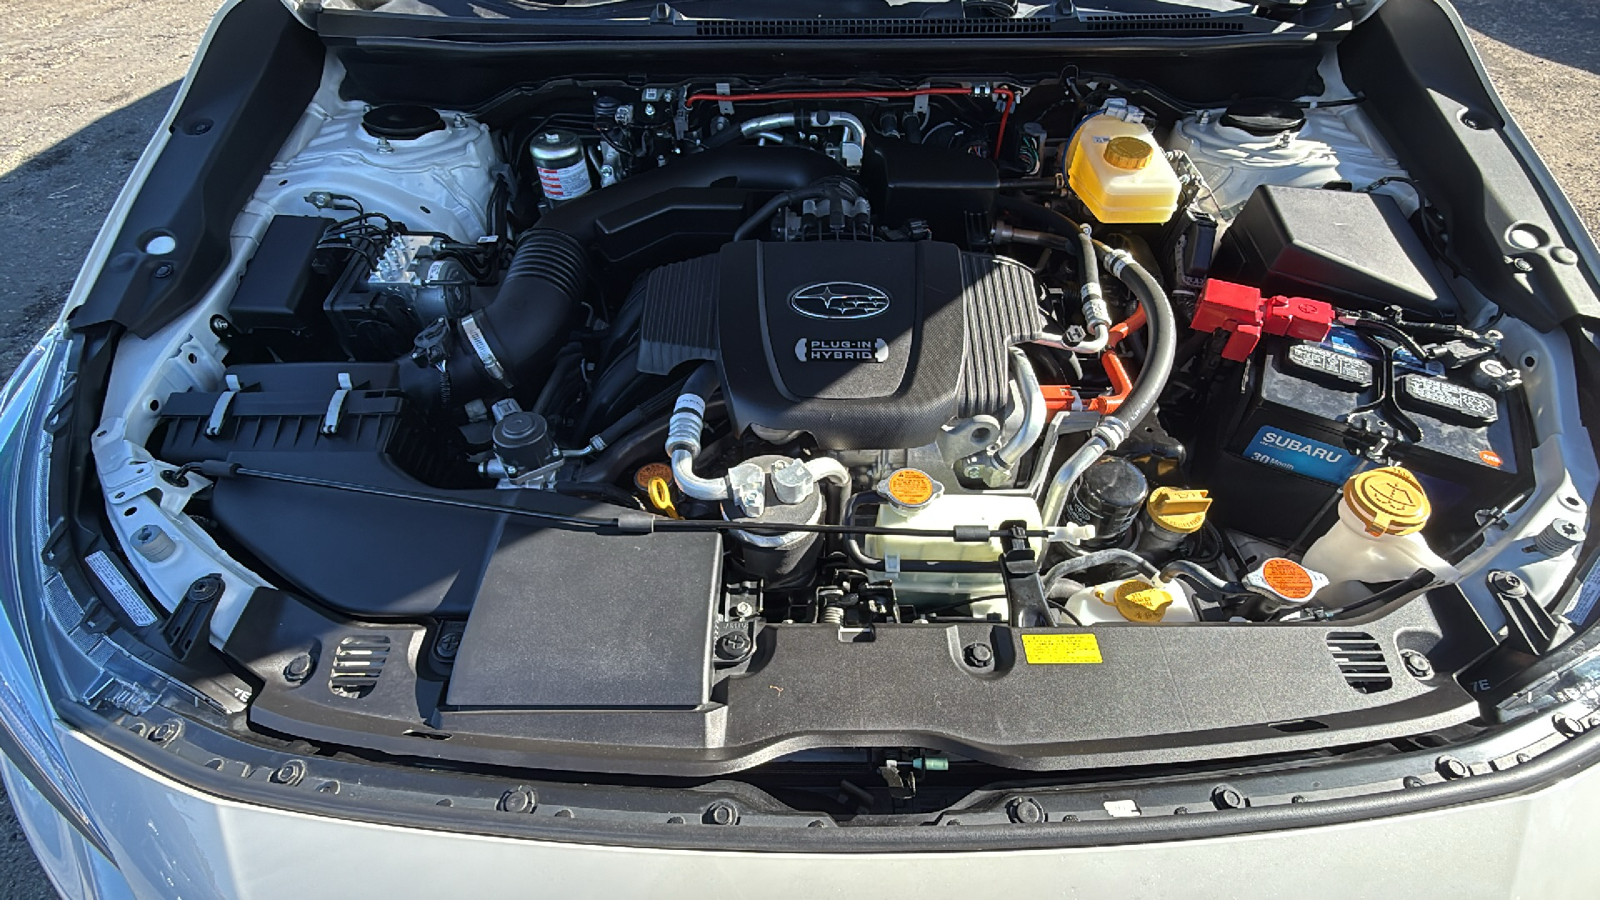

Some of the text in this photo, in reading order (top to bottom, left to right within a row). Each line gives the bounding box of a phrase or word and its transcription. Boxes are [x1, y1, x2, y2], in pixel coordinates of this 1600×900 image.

[811, 341, 872, 349] PLUG-IN
[811, 351, 873, 359] HYBRID
[1262, 432, 1342, 463] SUBARU
[1251, 451, 1270, 464] 30
